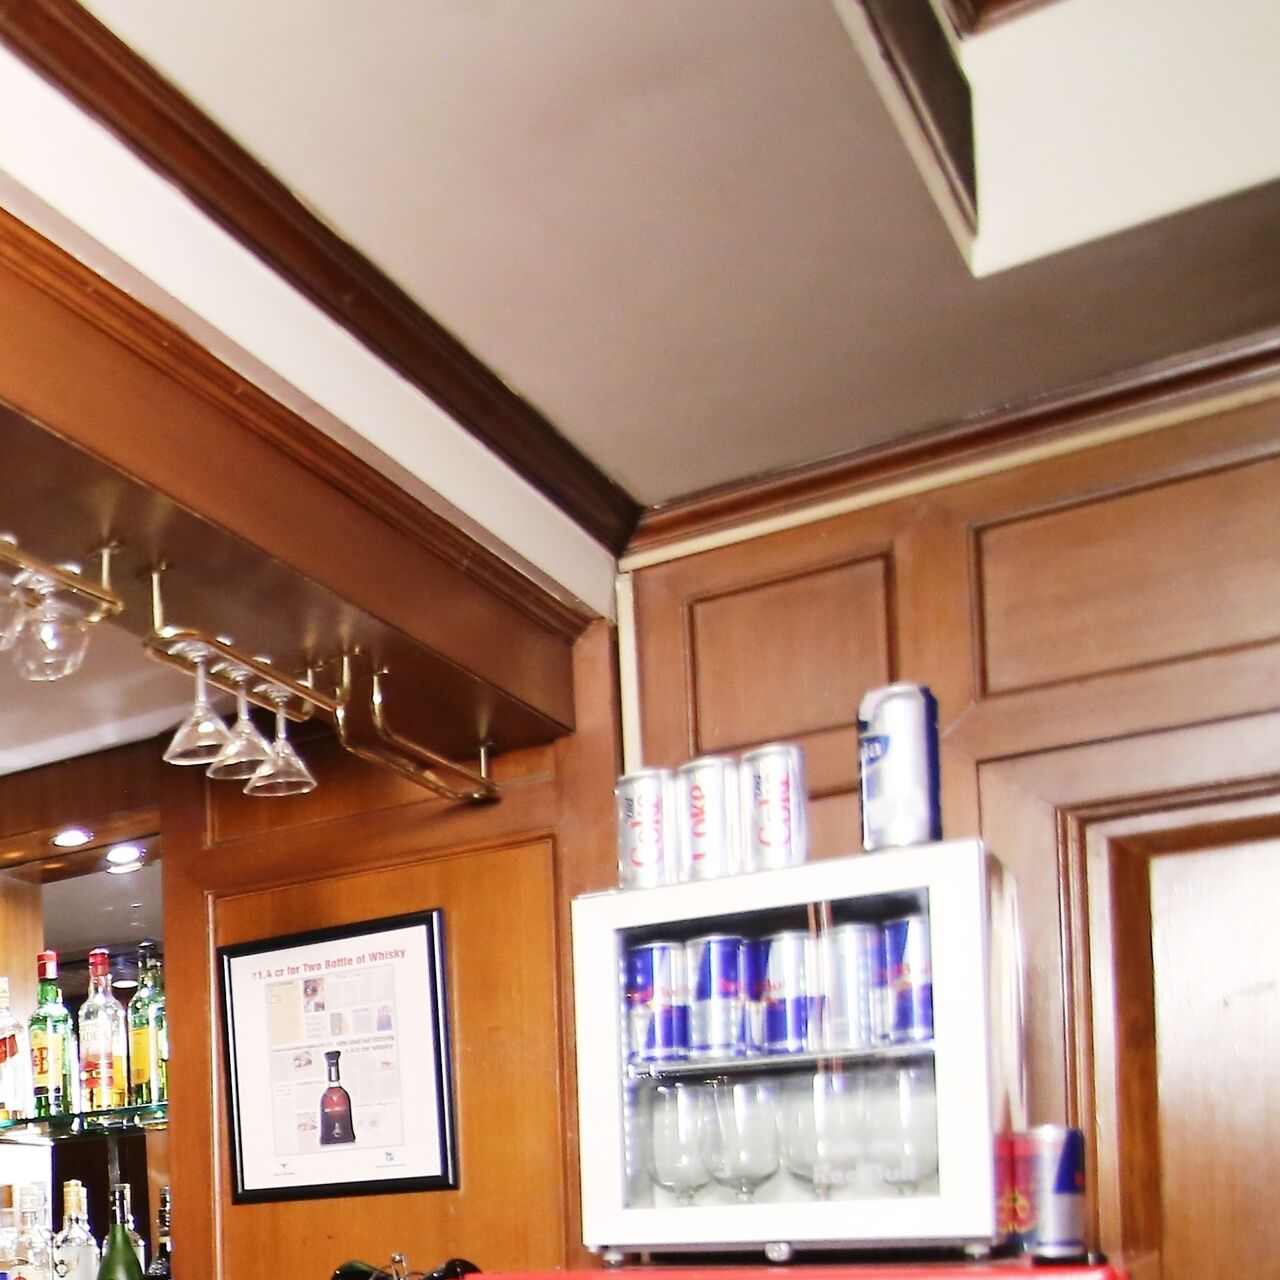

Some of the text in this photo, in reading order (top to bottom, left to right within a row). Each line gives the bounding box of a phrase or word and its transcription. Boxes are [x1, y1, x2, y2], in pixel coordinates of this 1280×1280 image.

[287, 965, 300, 976] for
[303, 962, 322, 973] Two
[325, 956, 353, 970] Bottle
[356, 953, 366, 965] of
[369, 948, 406, 962] Whisky
